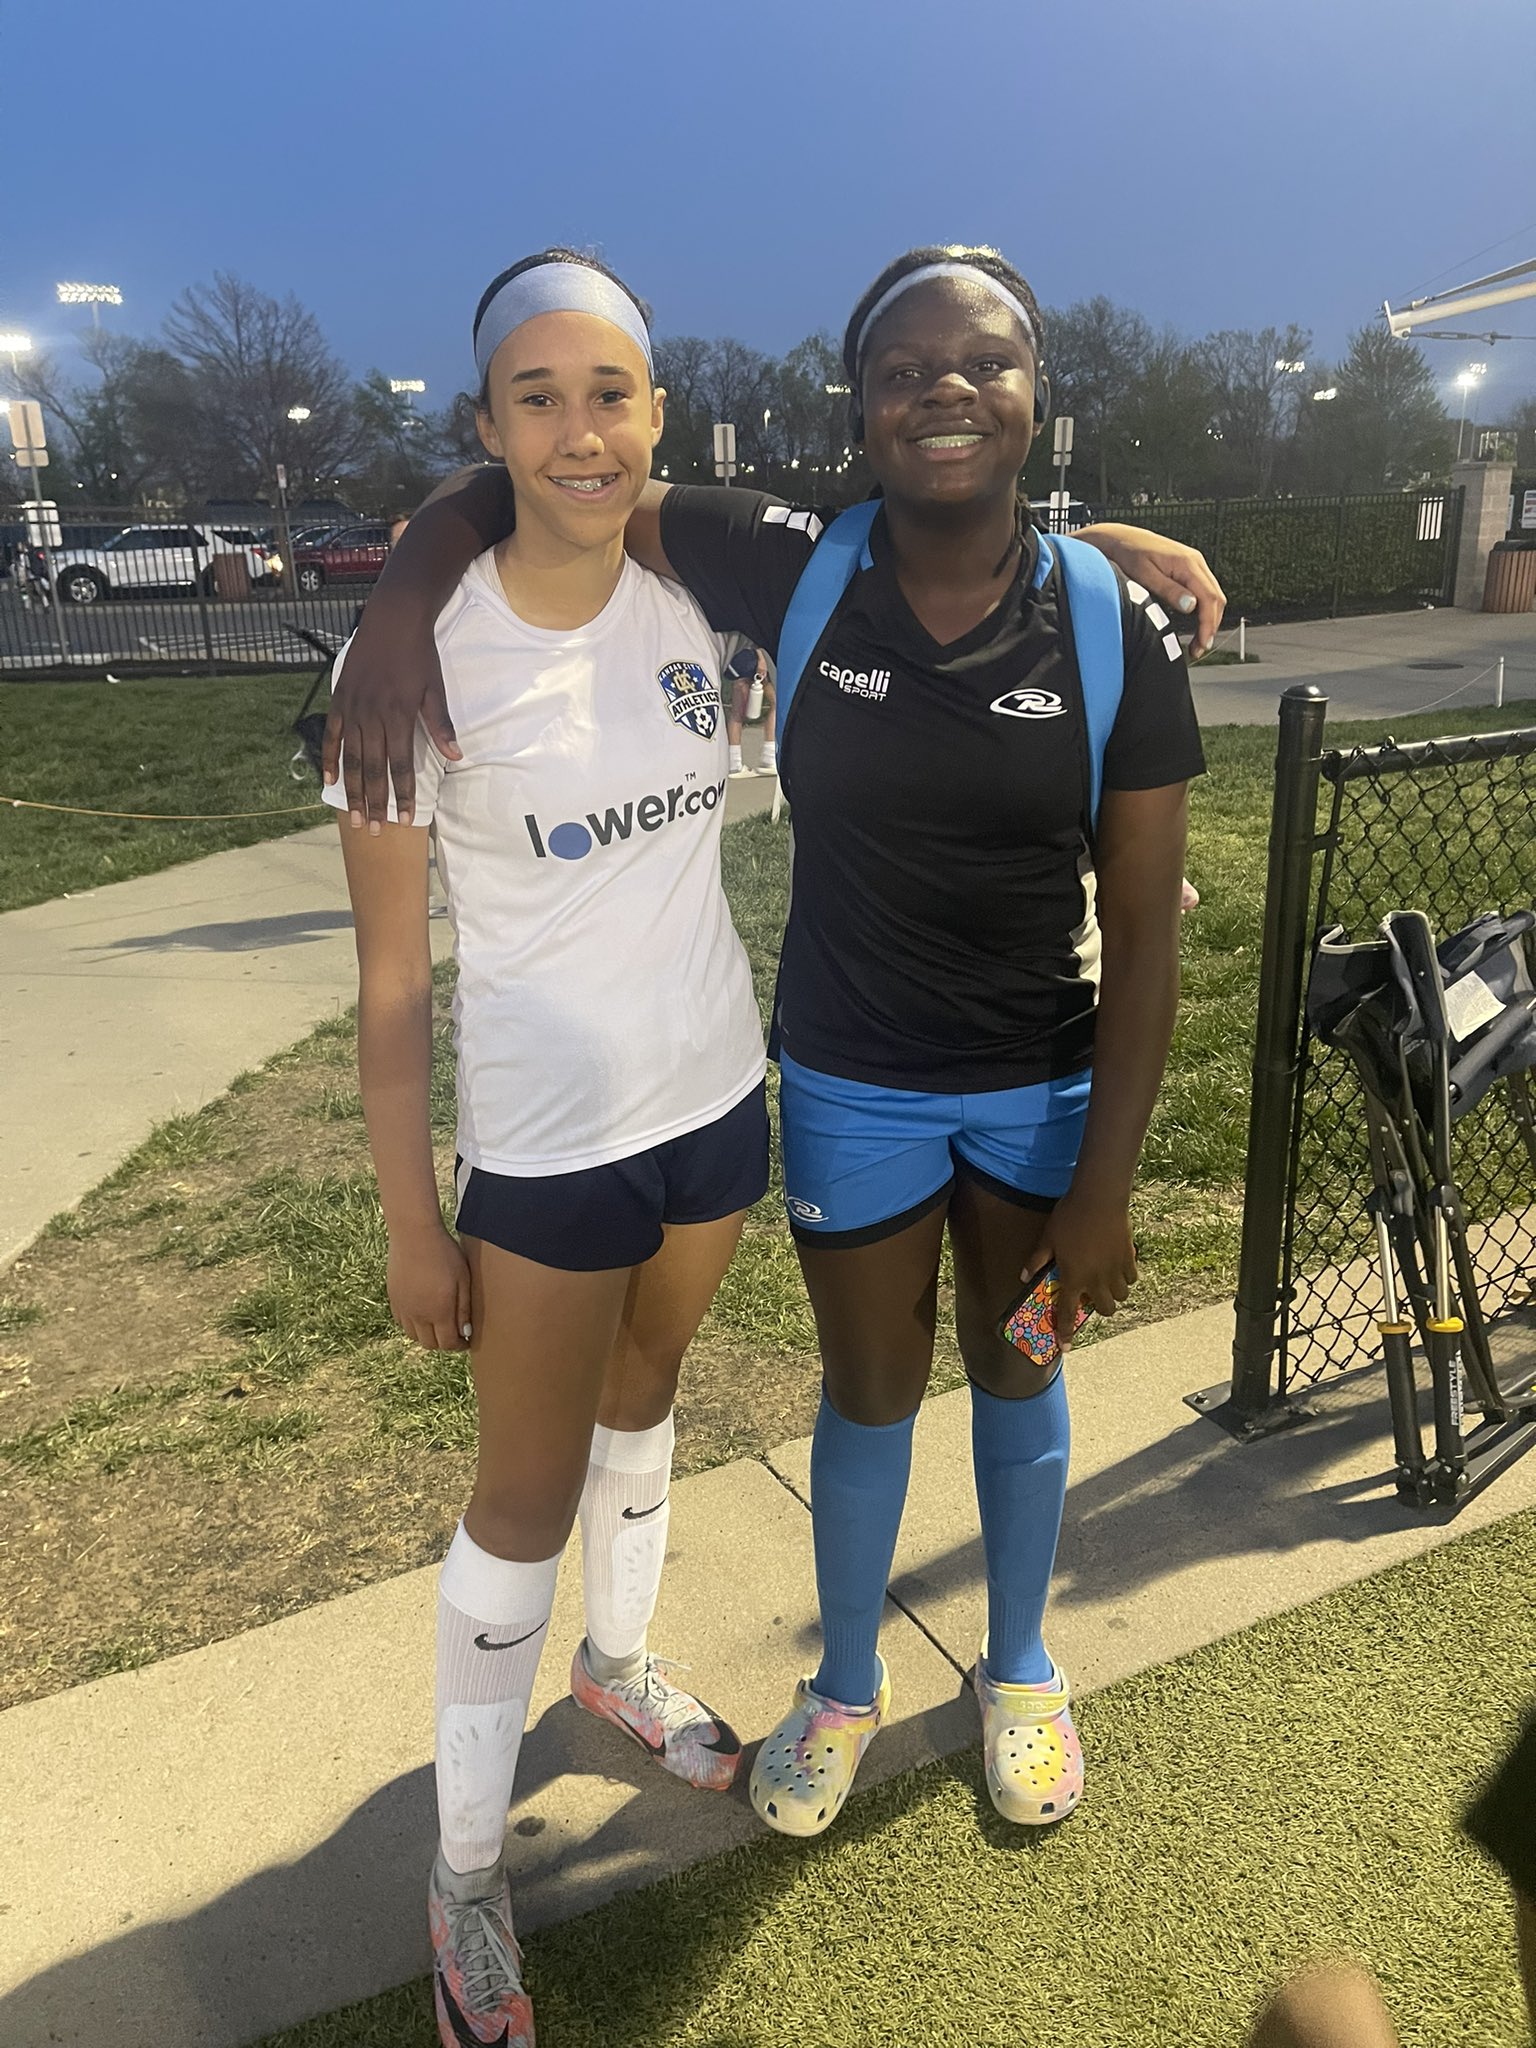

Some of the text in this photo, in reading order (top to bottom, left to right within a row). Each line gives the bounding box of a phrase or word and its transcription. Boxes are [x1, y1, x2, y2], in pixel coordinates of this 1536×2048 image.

[682, 663, 701, 671] CITY
[820, 660, 891, 693] capelli
[672, 691, 720, 717] ATHLETICS
[843, 684, 887, 702] SPORT
[1449, 1360, 1459, 1425] FREESTYLE
